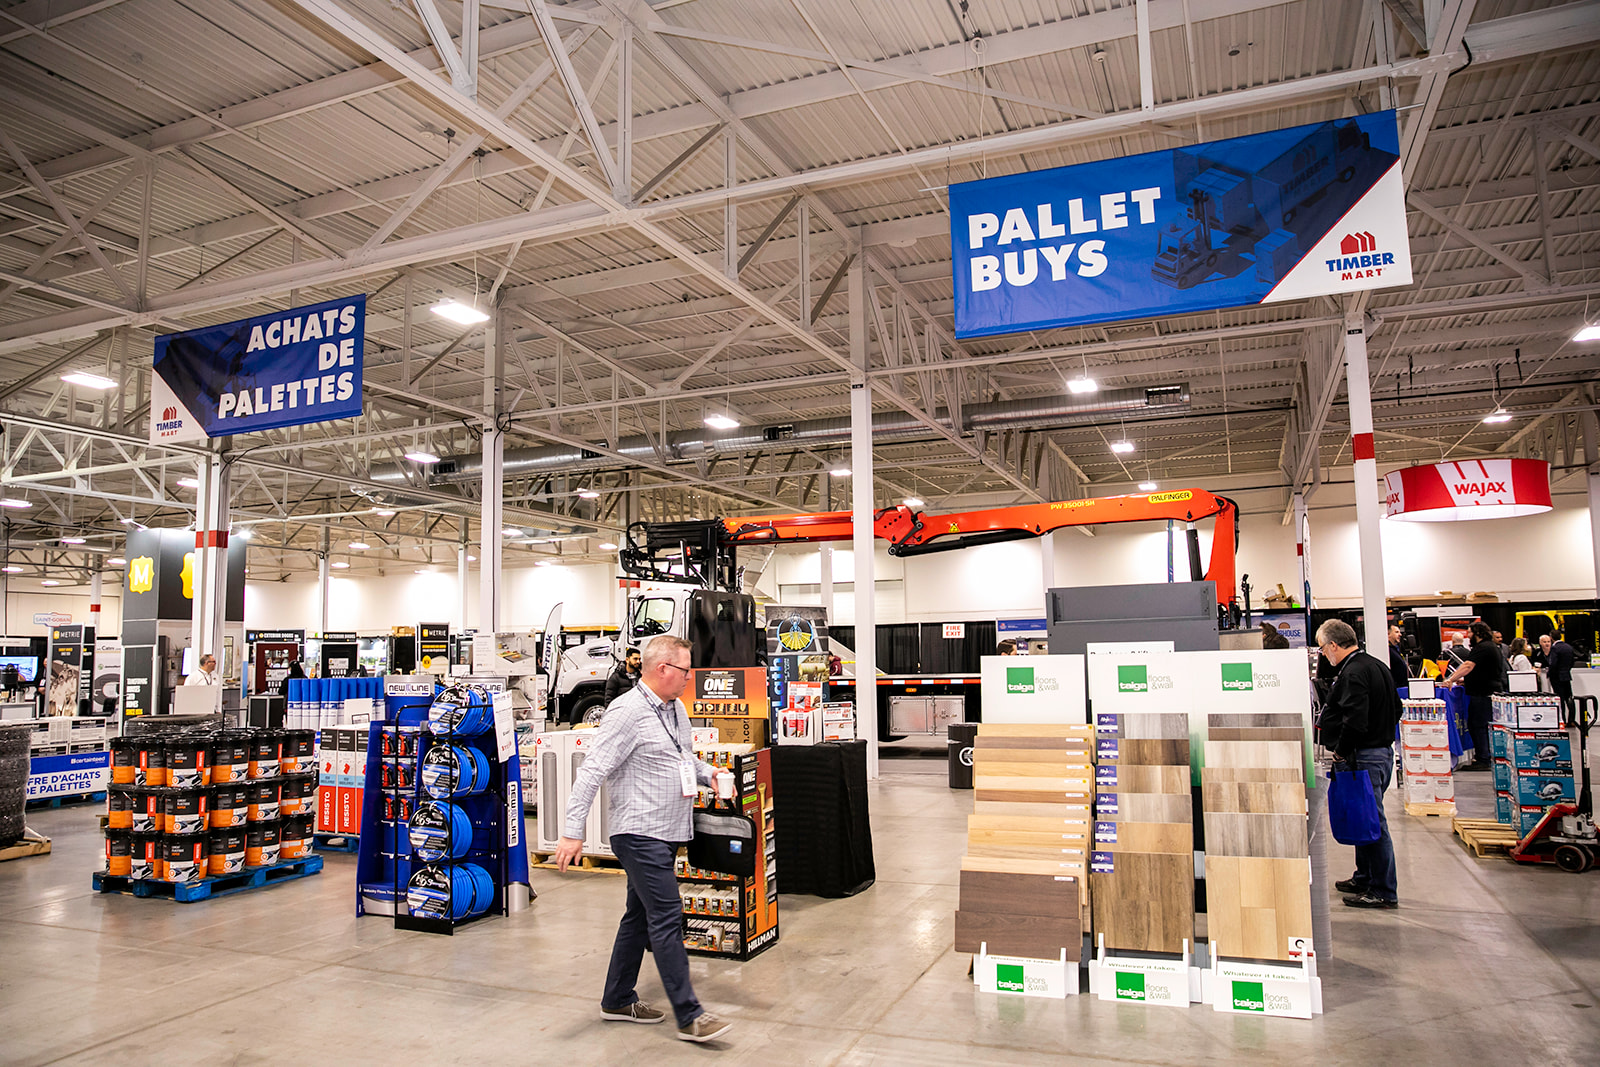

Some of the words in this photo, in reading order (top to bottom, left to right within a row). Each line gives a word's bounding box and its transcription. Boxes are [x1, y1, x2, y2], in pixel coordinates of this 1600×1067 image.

[968, 186, 1162, 250] PALLET
[970, 240, 1108, 292] BUYS
[1326, 252, 1394, 272] TIMBER
[1341, 268, 1382, 280] MART
[246, 306, 356, 352] ACHATS
[318, 338, 354, 371] DE
[218, 372, 354, 419] PALETTES
[156, 420, 182, 431] TIMBER
[1454, 482, 1506, 496] WAJAX
[1151, 492, 1190, 502] PALFINGER
[134, 564, 149, 586] M
[60, 630, 80, 638] METRIE
[1254, 672, 1278, 680] floors
[1008, 682, 1034, 692] taiga
[1038, 683, 1059, 691] &wall
[1120, 682, 1147, 691] taiga
[1151, 682, 1173, 690] &wall
[1223, 680, 1252, 689] taiga
[1257, 680, 1280, 688] &wall
[27, 776, 48, 786] FRE
[51, 771, 100, 784] D'ACHATS
[40, 780, 91, 794] PALETTES
[748, 927, 777, 952] HILLMAN
[998, 980, 1023, 990] taiga
[1025, 976, 1046, 984] floors
[1027, 983, 1048, 991] &wall
[1146, 984, 1168, 992] floors
[1117, 988, 1144, 998] taiga
[1149, 992, 1171, 1000] &wall
[1265, 993, 1288, 1002] floors
[1234, 999, 1263, 1009] taiga
[1268, 1002, 1291, 1010] &wall
